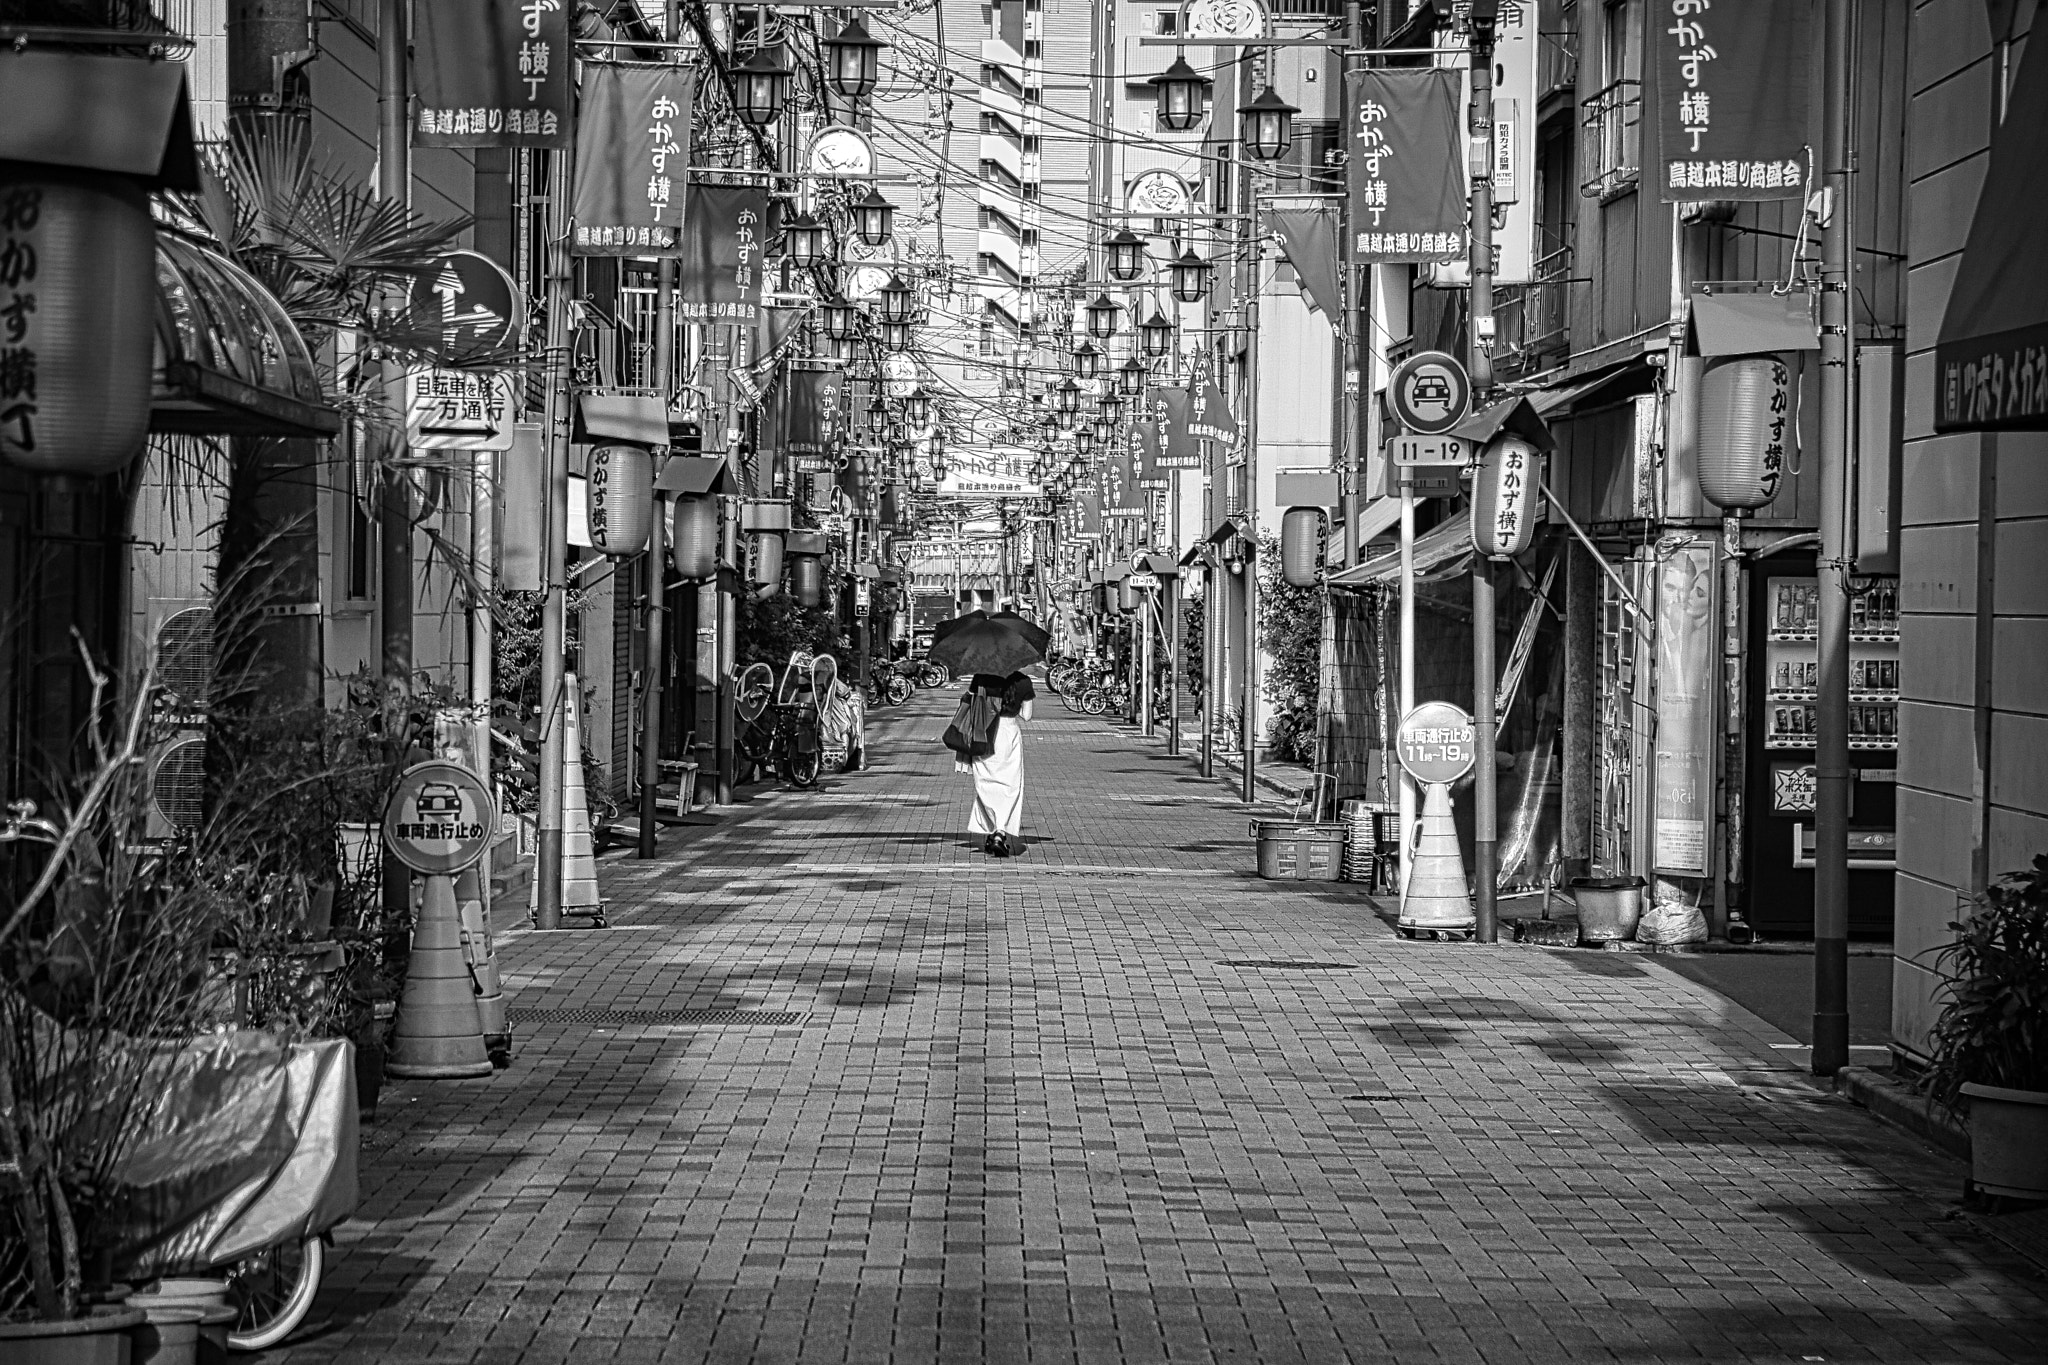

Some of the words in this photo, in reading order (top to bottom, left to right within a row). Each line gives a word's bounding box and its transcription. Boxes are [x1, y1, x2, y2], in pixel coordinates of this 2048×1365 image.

[418, 108, 557, 135] 鳥越本通り商盛会
[648, 95, 679, 222] おかず横丁
[1357, 100, 1393, 226] おかず横丁
[1499, 123, 1509, 170] 防犯カメラ設置
[1669, 160, 1800, 189] 鳥越本通り商盛会
[577, 226, 674, 248] 鳥越本通り商盛
[736, 208, 758, 299] おかず横丁
[1356, 232, 1460, 253] 鳥越本通り商盛会
[416, 399, 504, 421] 一方通行
[822, 384, 836, 441] おかず横丁
[1156, 400, 1171, 455] おかず横丁
[1761, 363, 1788, 497] おかず横丁
[1131, 431, 1145, 479] おかず横丁
[1402, 442, 1460, 460] 11-19
[1497, 451, 1523, 547] おかず横丁
[1402, 728, 1473, 744] 車両通行止め
[396, 822, 484, 840] 車両通行止め
